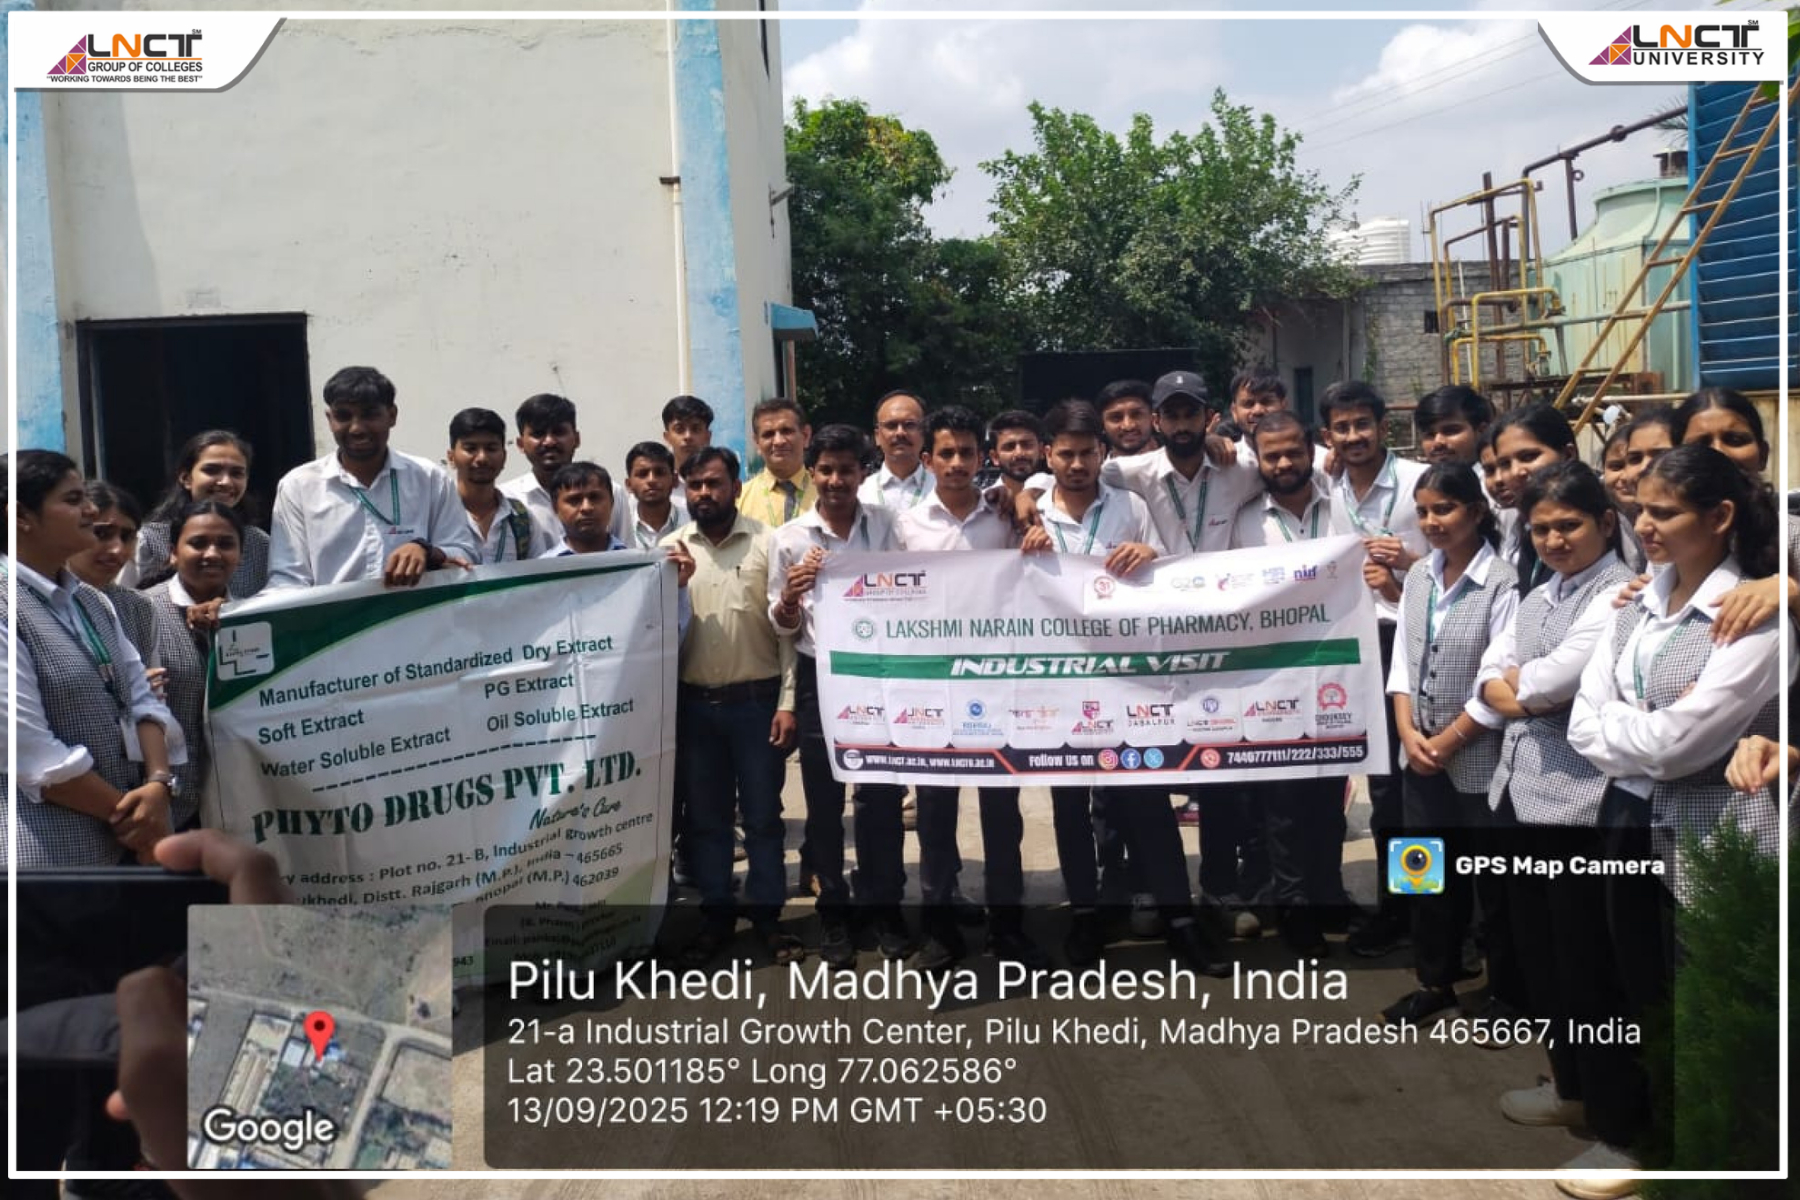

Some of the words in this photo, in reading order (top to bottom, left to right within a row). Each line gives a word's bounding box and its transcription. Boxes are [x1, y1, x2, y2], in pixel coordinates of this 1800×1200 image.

[864, 572, 926, 587] LNCT
[886, 620, 963, 638] LAKSHMI
[970, 618, 1034, 638] NARAIN
[1041, 617, 1113, 637] COLLEGE
[1118, 618, 1141, 638] OF
[1260, 604, 1331, 629] BHOPAL
[258, 671, 379, 707] Manufacturer
[384, 667, 401, 684] of
[405, 648, 513, 680] Standardized
[522, 642, 551, 662] Dry
[556, 635, 614, 657] Extract
[950, 656, 1138, 676] INDUSTRIAL
[1146, 652, 1232, 672] VISIT
[484, 680, 510, 700] PG
[516, 673, 574, 694] Extract
[486, 714, 509, 733] Oil
[514, 706, 576, 728] Soluble
[580, 698, 634, 720] Extract
[1126, 704, 1174, 718] LNCT
[1256, 700, 1300, 712] LNCT
[258, 722, 297, 745] Soft
[302, 708, 364, 736] Extract
[261, 758, 316, 779] Water
[319, 741, 386, 770] Soluble
[390, 726, 451, 756] Extract
[251, 802, 374, 844] PHYTO
[384, 783, 495, 827] DRUGS
[502, 767, 576, 799] PVT.
[584, 751, 642, 791] LTD.
[300, 872, 364, 886] address
[379, 866, 412, 880] Plot
[416, 861, 442, 874] no.
[494, 829, 561, 857] Industrial
[566, 824, 612, 841] growth
[615, 812, 653, 833] centre
[363, 890, 407, 905] Distt.
[412, 874, 472, 898] Rajgarh
[527, 868, 570, 886] (M.P.)
[572, 866, 620, 888] 462039
